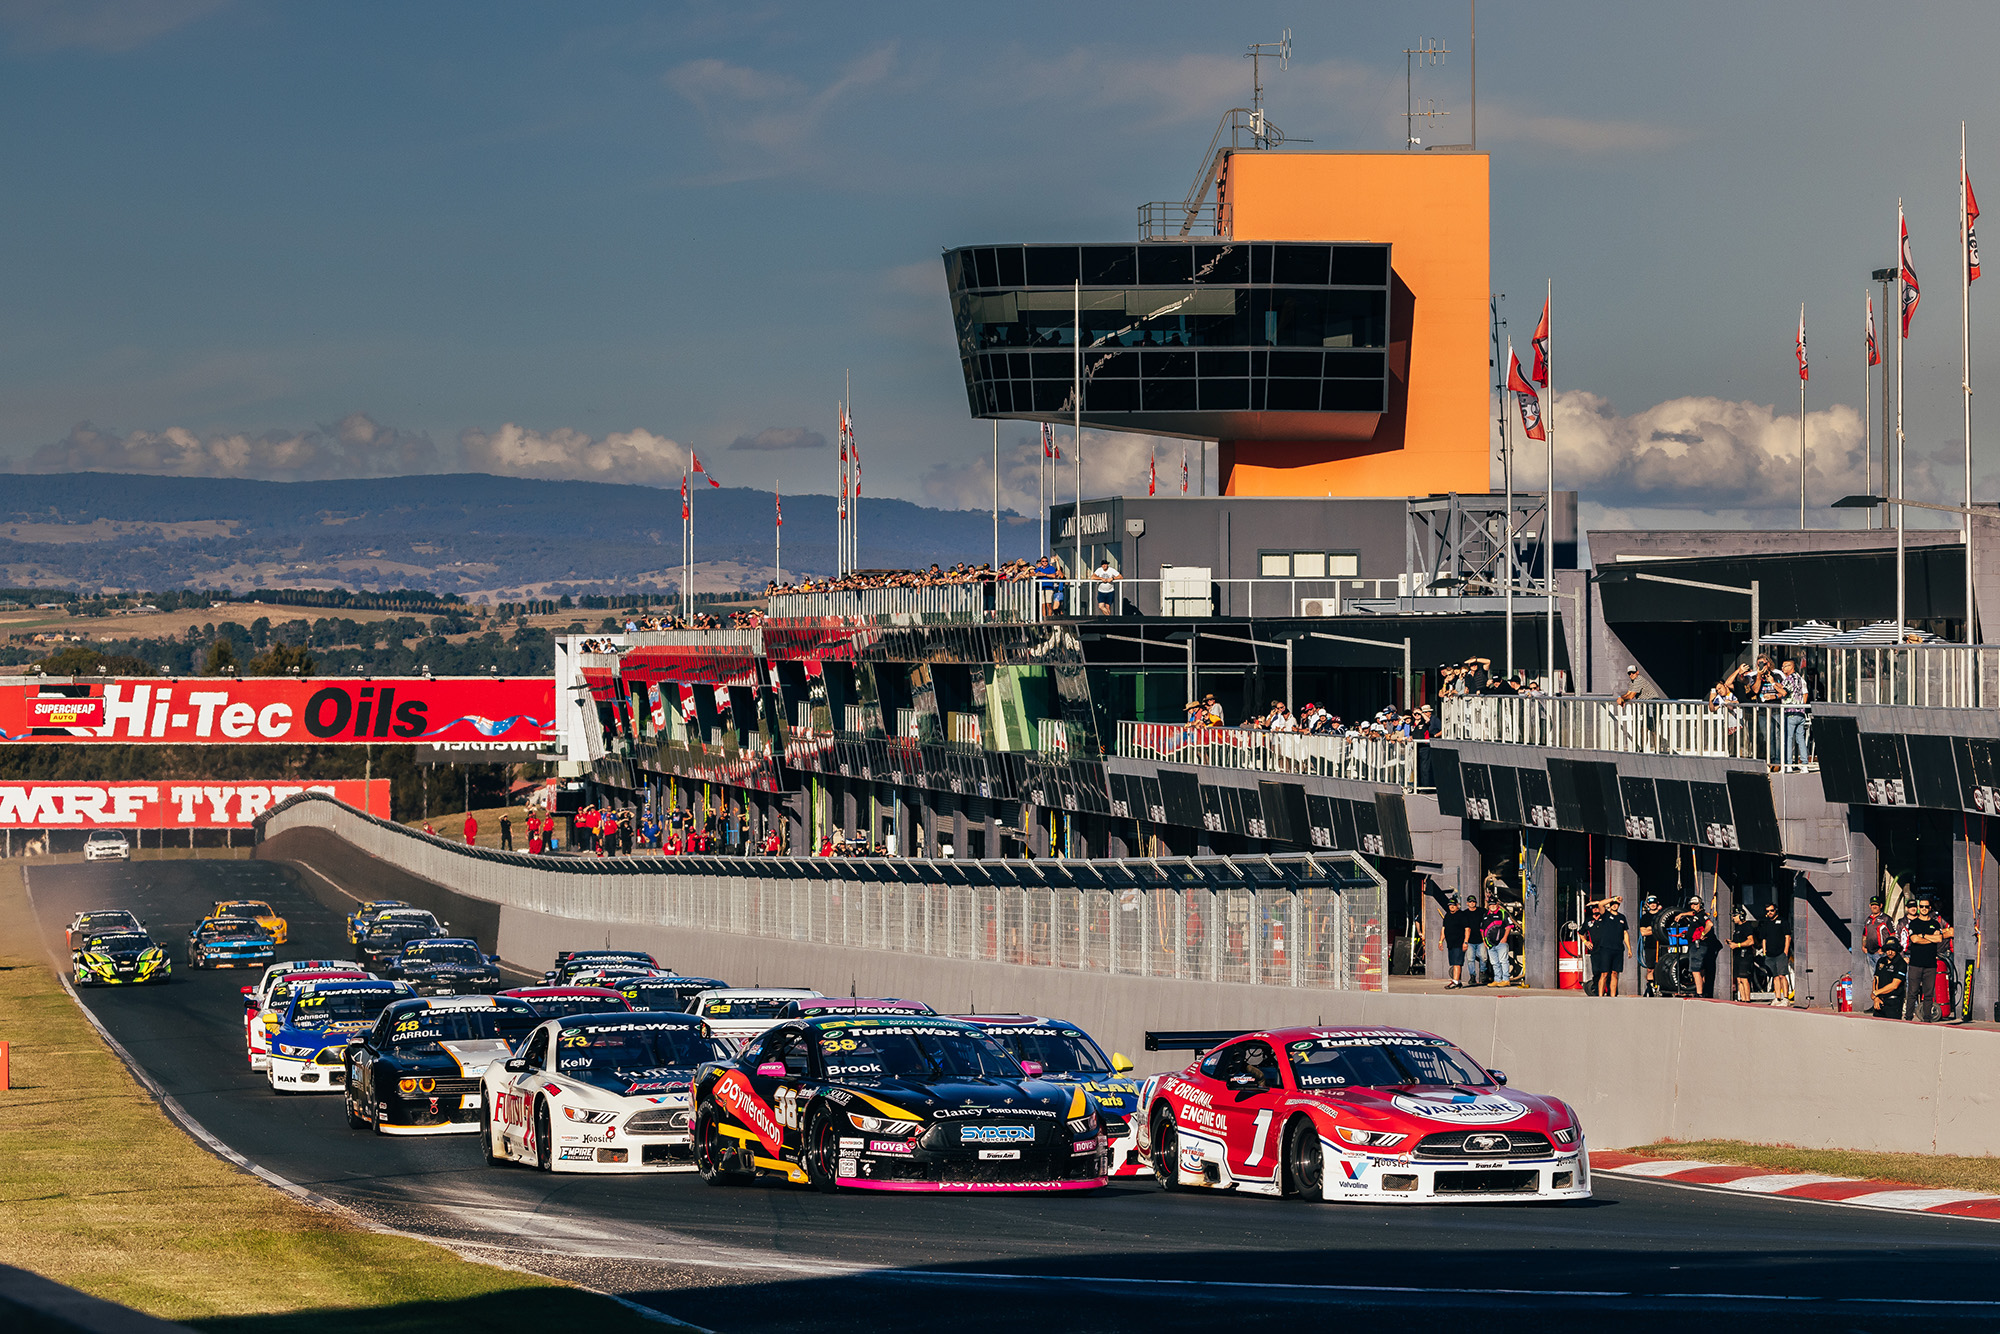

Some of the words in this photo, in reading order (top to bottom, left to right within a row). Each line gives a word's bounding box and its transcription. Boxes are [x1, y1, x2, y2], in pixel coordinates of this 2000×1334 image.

[34, 703, 96, 715] SUPERCHEAP
[99, 684, 292, 737] Hi-Tec
[304, 685, 428, 738] Oils
[0, 786, 159, 823] MRF
[171, 785, 335, 822] TYR
[277, 987, 287, 996] 2
[318, 988, 391, 997] TurtleWax
[297, 996, 326, 1008] 117
[522, 995, 601, 1003] TurtleWax
[419, 1006, 509, 1017] TurtleWax
[710, 1004, 731, 1014] 99
[825, 1006, 915, 1015] TurtleWax
[294, 1012, 329, 1022] Johnson
[396, 1020, 419, 1032] 48
[585, 1024, 690, 1033] TurtleWax
[980, 1027, 1058, 1036] rtleWax
[391, 1029, 443, 1042] CARROLL
[848, 1027, 960, 1037] TurtleWax
[1310, 1030, 1420, 1039] Valvoline
[564, 1036, 588, 1048] 73
[824, 1038, 857, 1052] 38
[1317, 1038, 1426, 1048] TurtleWax
[1298, 1051, 1309, 1062] 1
[560, 1057, 593, 1069] Kelly
[827, 1063, 882, 1075] Brook
[277, 1075, 297, 1083] MAN
[1301, 1075, 1345, 1086] Herne
[1161, 1077, 1180, 1092] THE
[1174, 1082, 1214, 1110] ORIGINAL
[717, 1077, 781, 1146] paynterdixon
[773, 1085, 798, 1131] 38
[933, 1108, 983, 1119] Clancy
[1012, 1109, 1057, 1118] BATHURST
[1413, 1103, 1518, 1116] VALVOLINE
[1180, 1104, 1216, 1128] ENGINE
[1215, 1113, 1228, 1131] OIL
[961, 1126, 1035, 1139] SYDCON
[1244, 1109, 1274, 1167] 1
[561, 1147, 593, 1157] EMPIRE
[873, 1142, 904, 1152] nova
[1339, 1181, 1369, 1189] Valvoline
